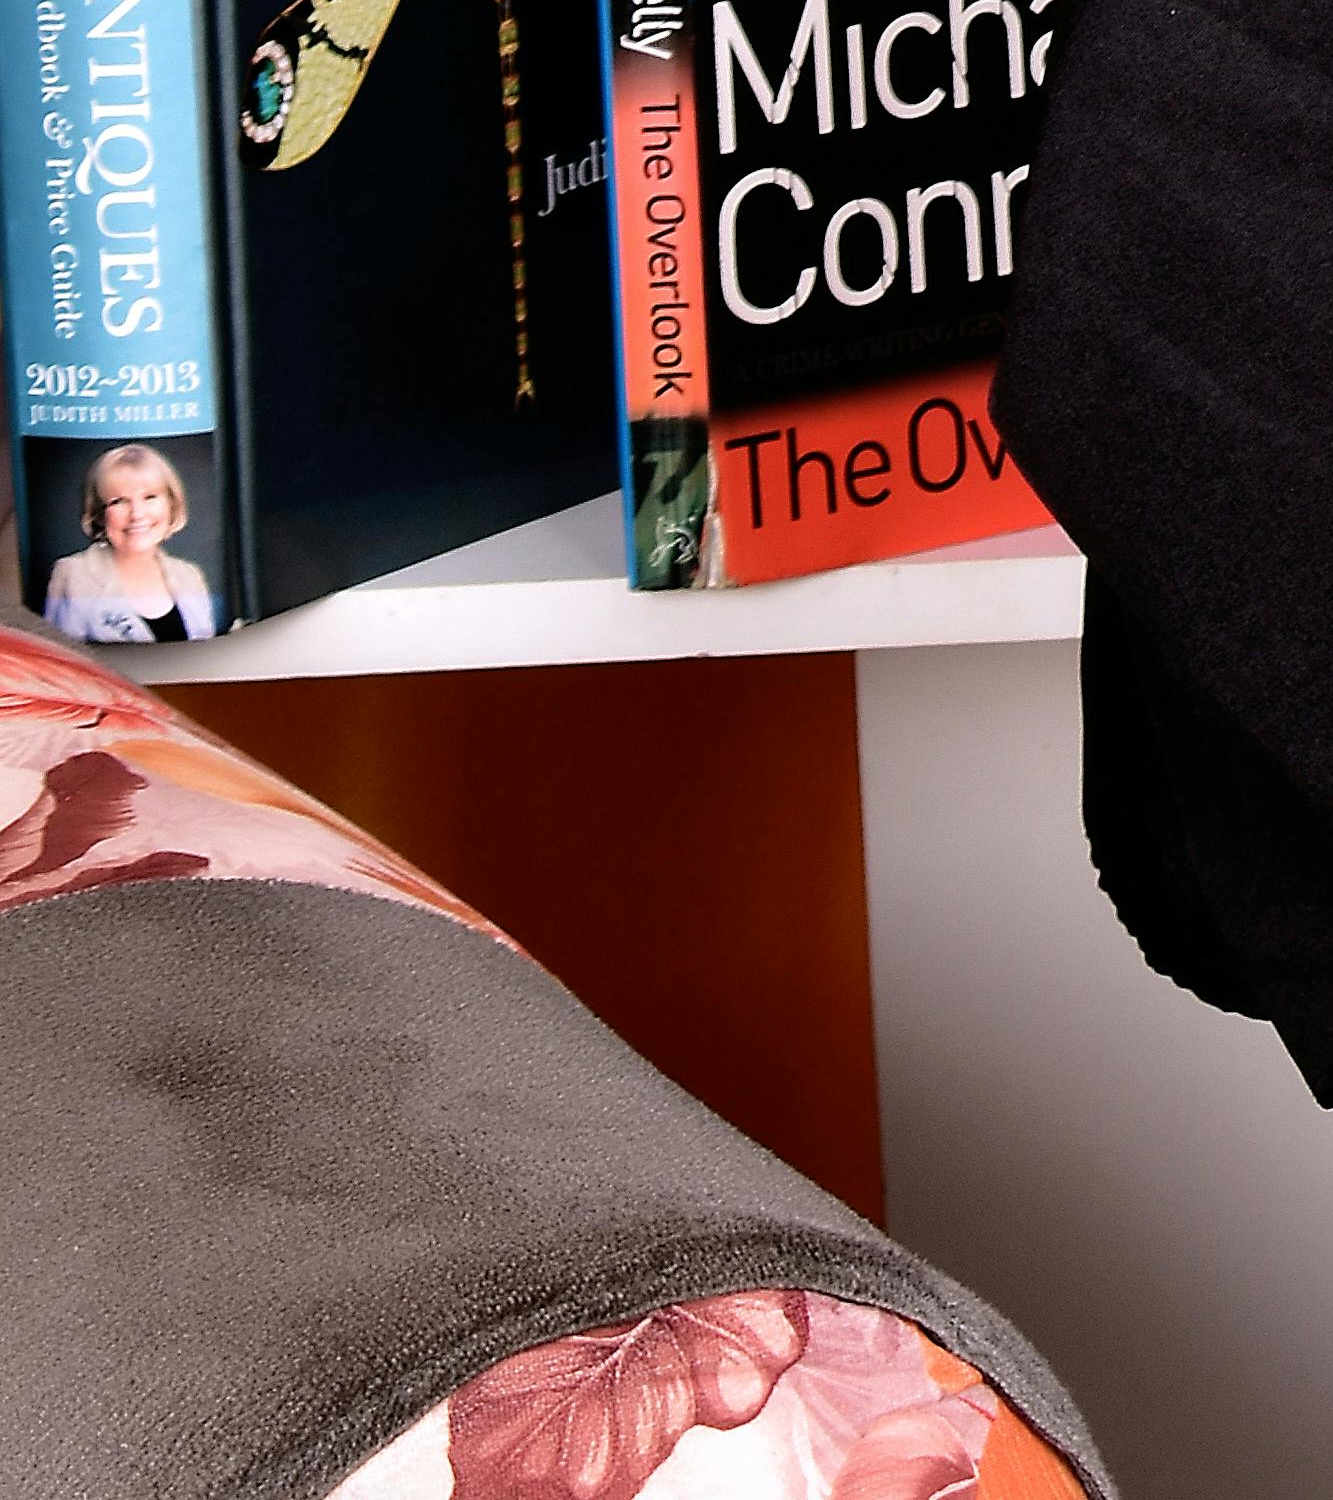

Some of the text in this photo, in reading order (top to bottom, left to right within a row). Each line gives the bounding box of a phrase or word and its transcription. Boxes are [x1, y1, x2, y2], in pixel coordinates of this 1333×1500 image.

[43, 112, 72, 150] &
[46, 156, 75, 237] Price
[641, 94, 693, 398] The Overlook
[50, 243, 84, 340] Guide
[29, 402, 200, 426] JUDITH MILLER
[724, 425, 892, 530] The
